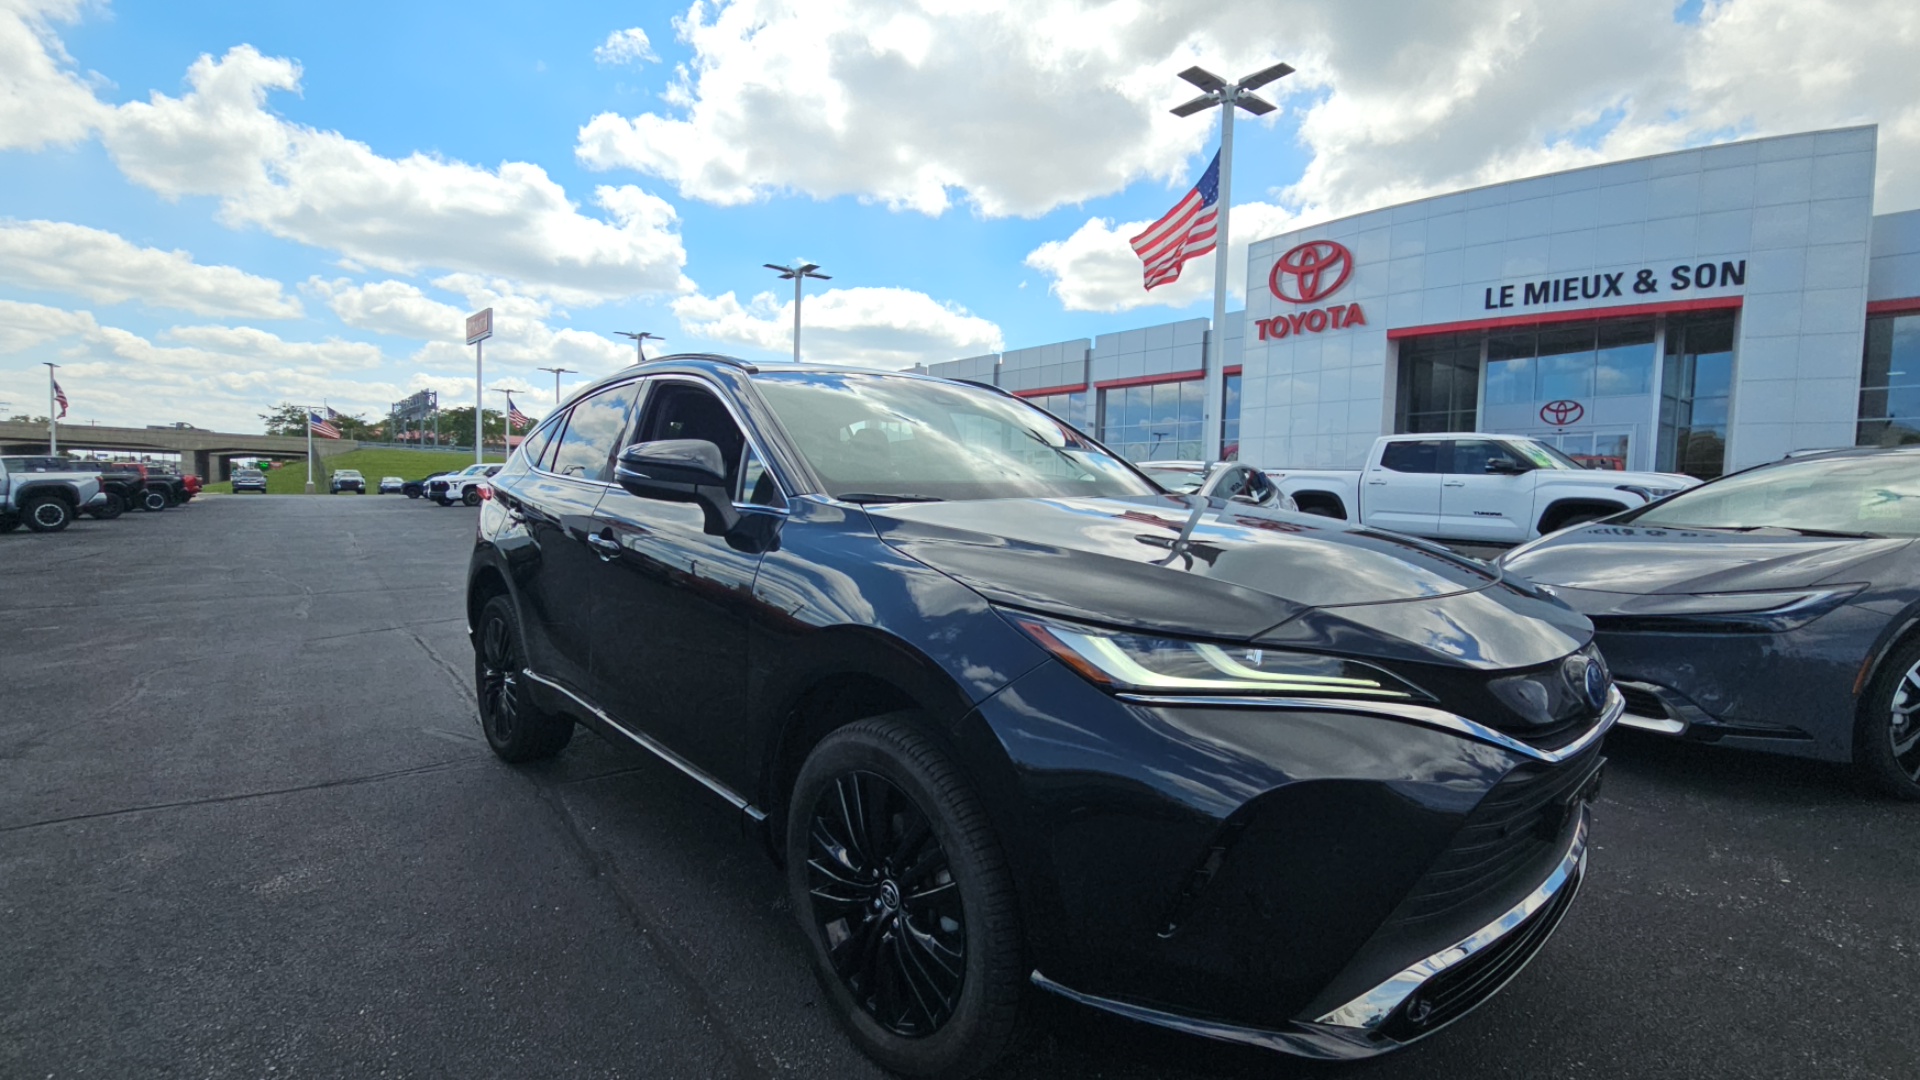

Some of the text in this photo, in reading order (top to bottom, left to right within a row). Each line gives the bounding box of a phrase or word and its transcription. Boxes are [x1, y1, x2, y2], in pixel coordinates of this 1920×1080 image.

[1485, 260, 1746, 310] LE MIEUX & SON
[1255, 303, 1365, 341] TOYOTA
